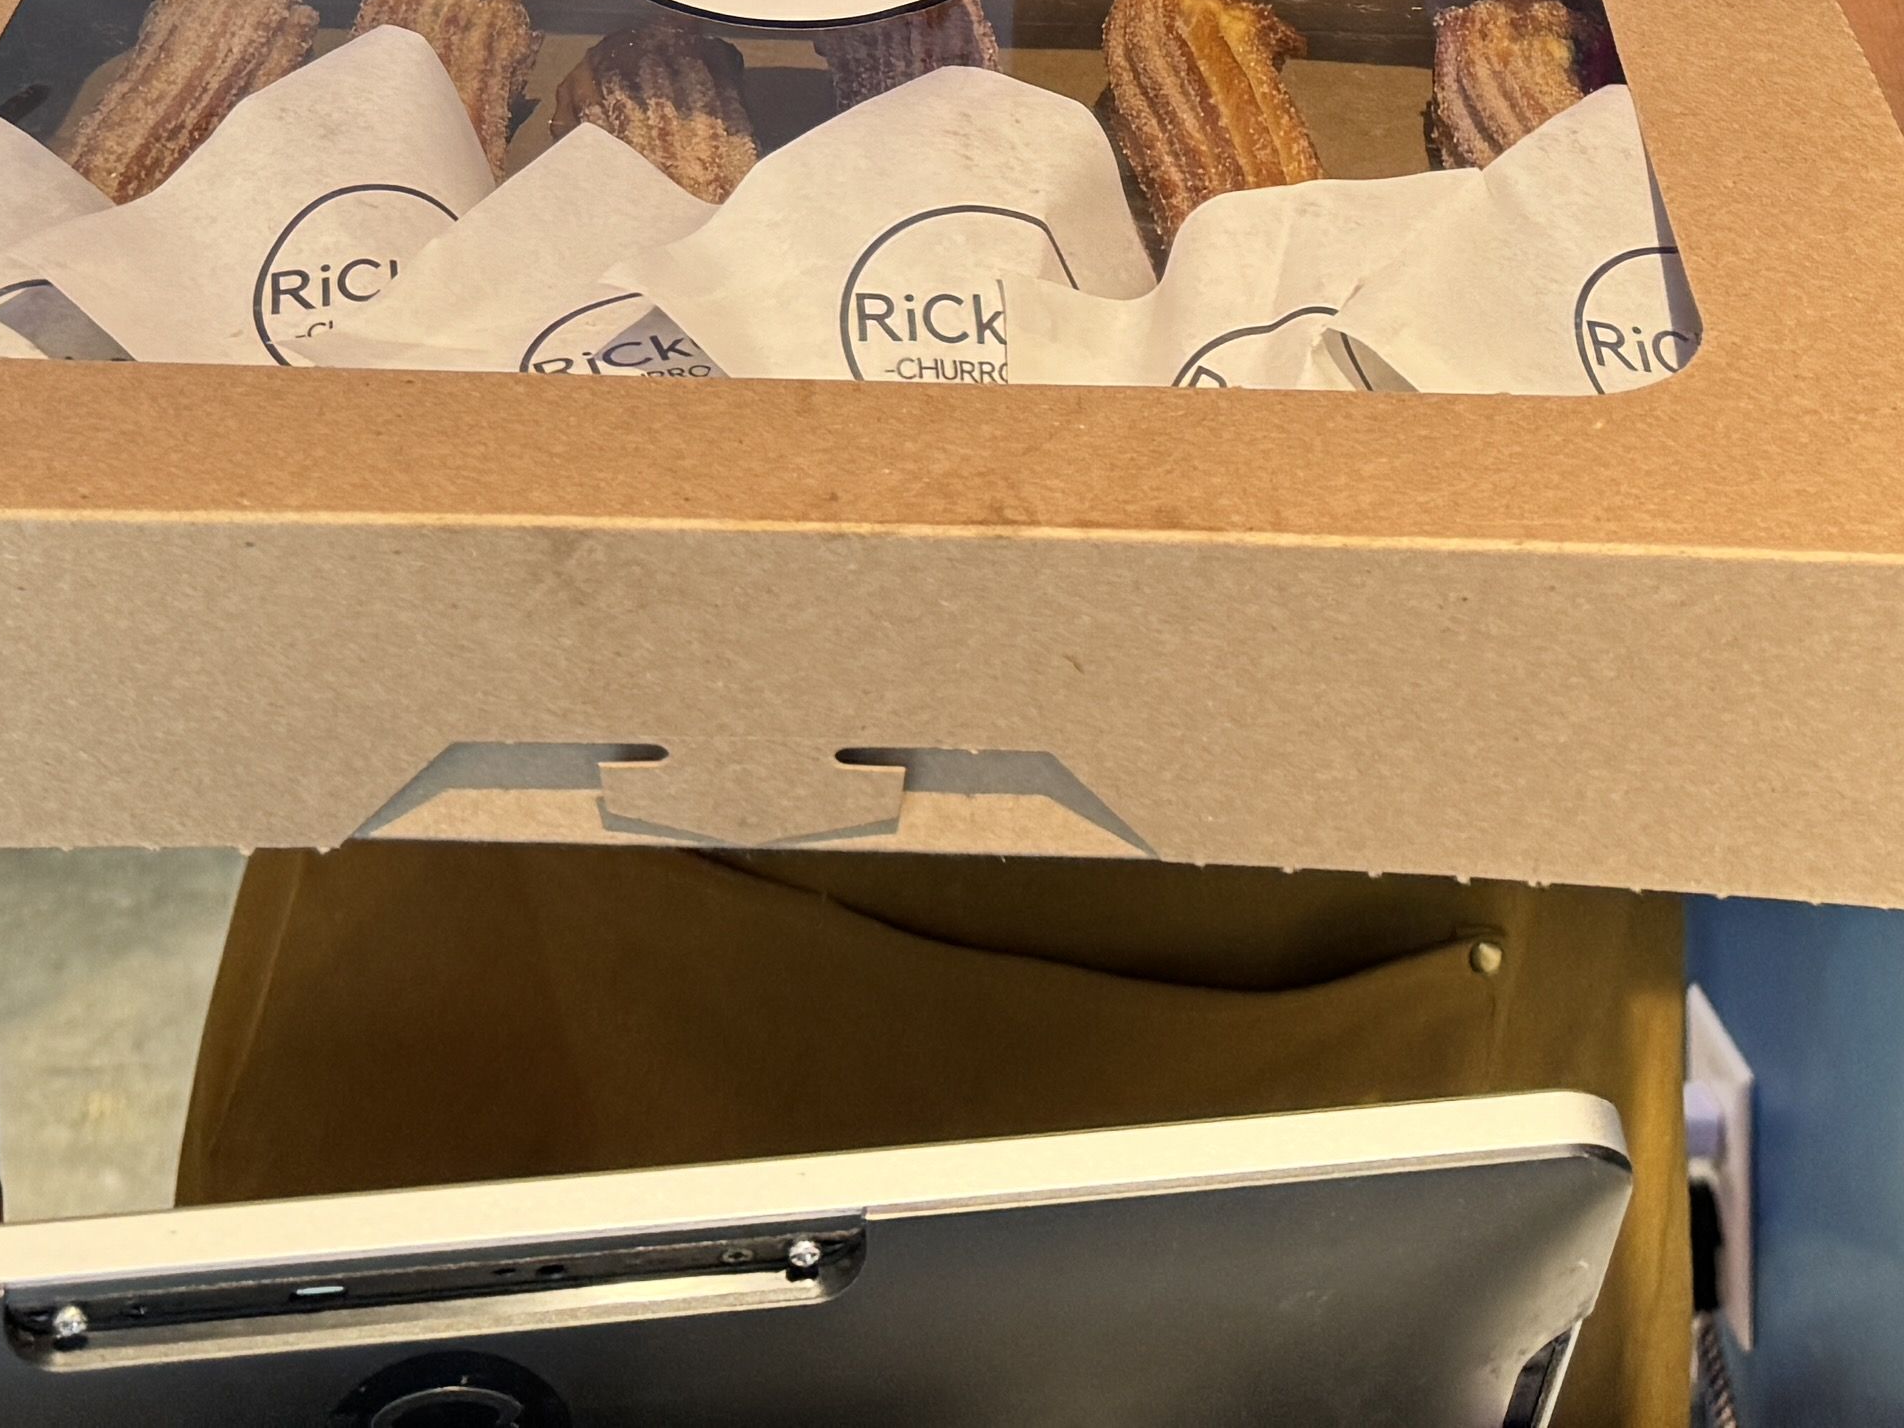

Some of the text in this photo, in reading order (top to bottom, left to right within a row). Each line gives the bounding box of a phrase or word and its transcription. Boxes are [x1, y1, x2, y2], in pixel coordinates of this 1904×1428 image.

[851, 291, 1008, 345] RiCk
[533, 335, 701, 375] RiCk
[1585, 319, 1702, 374] RiC
